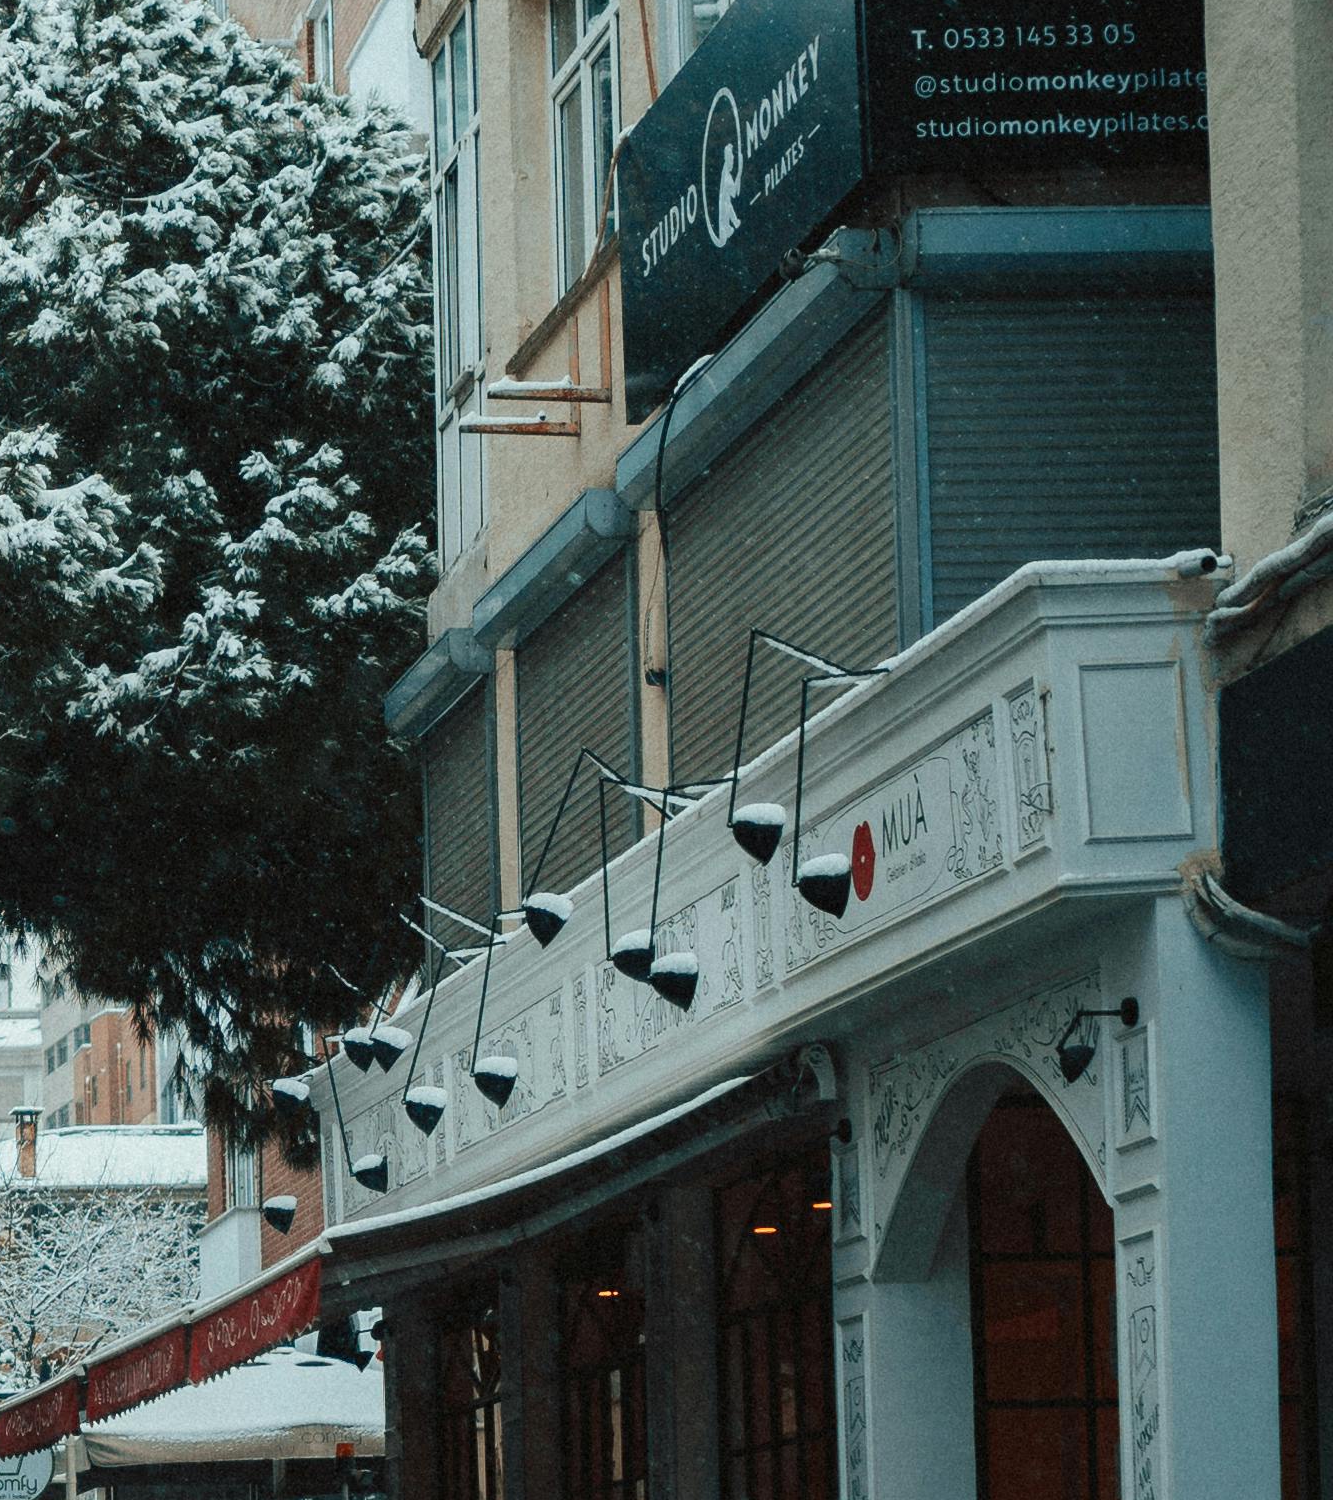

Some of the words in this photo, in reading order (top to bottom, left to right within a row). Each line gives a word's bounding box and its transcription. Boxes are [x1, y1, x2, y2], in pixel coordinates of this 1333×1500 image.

[943, 26, 1006, 49] 0533
[1015, 25, 1057, 47] 145
[1064, 24, 1094, 46] 33
[1102, 23, 1136, 45] 05
[641, 184, 698, 278] STUDIO
[745, 34, 821, 159] MONKEY
[763, 134, 806, 197] PILATES
